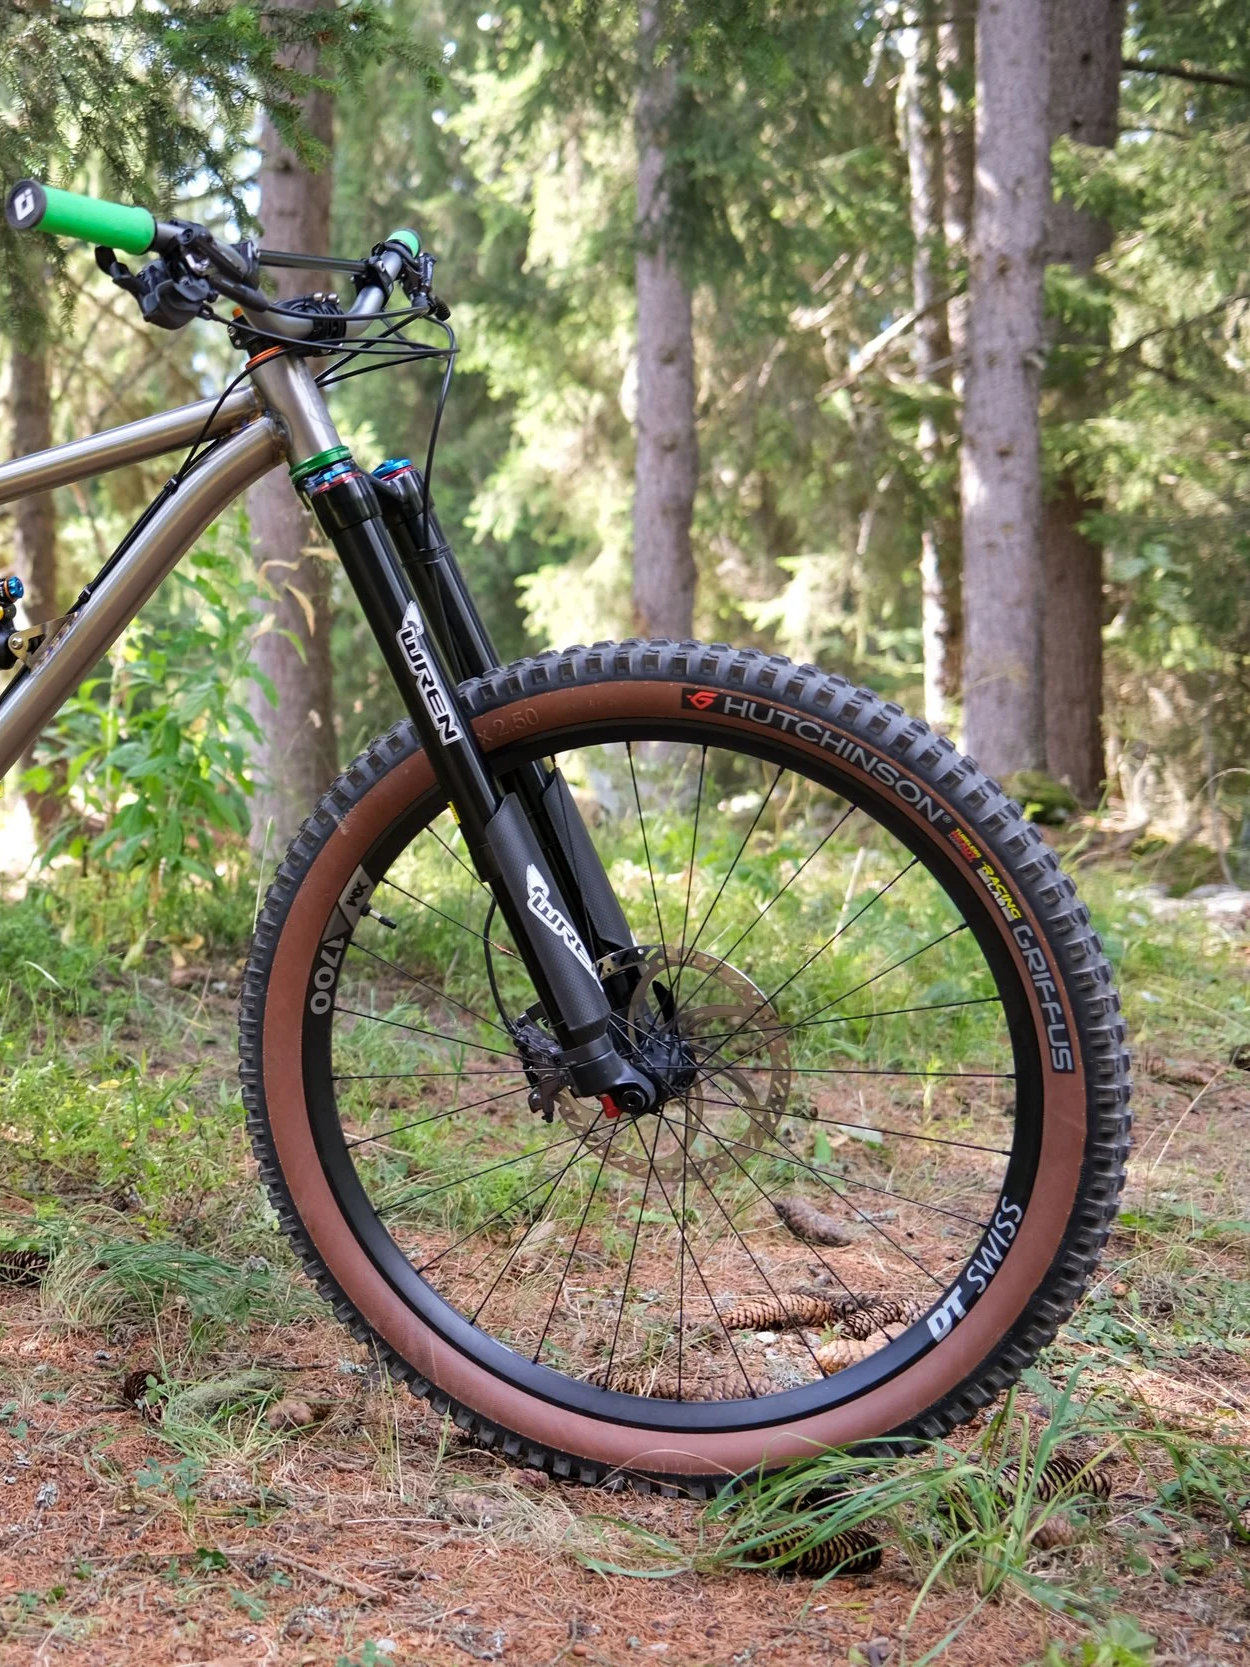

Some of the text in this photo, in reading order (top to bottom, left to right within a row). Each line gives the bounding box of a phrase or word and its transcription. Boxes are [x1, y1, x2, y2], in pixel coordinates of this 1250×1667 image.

[400, 629, 458, 741] WREN
[492, 707, 540, 737] 2.50
[723, 696, 945, 823] HUTCHINSON
[531, 895, 595, 973] WRE
[982, 863, 1022, 919] RACING
[310, 938, 344, 1015] 1700
[1013, 924, 1073, 1071] GRIFFUS
[926, 1196, 1023, 1342] DT SWISS
